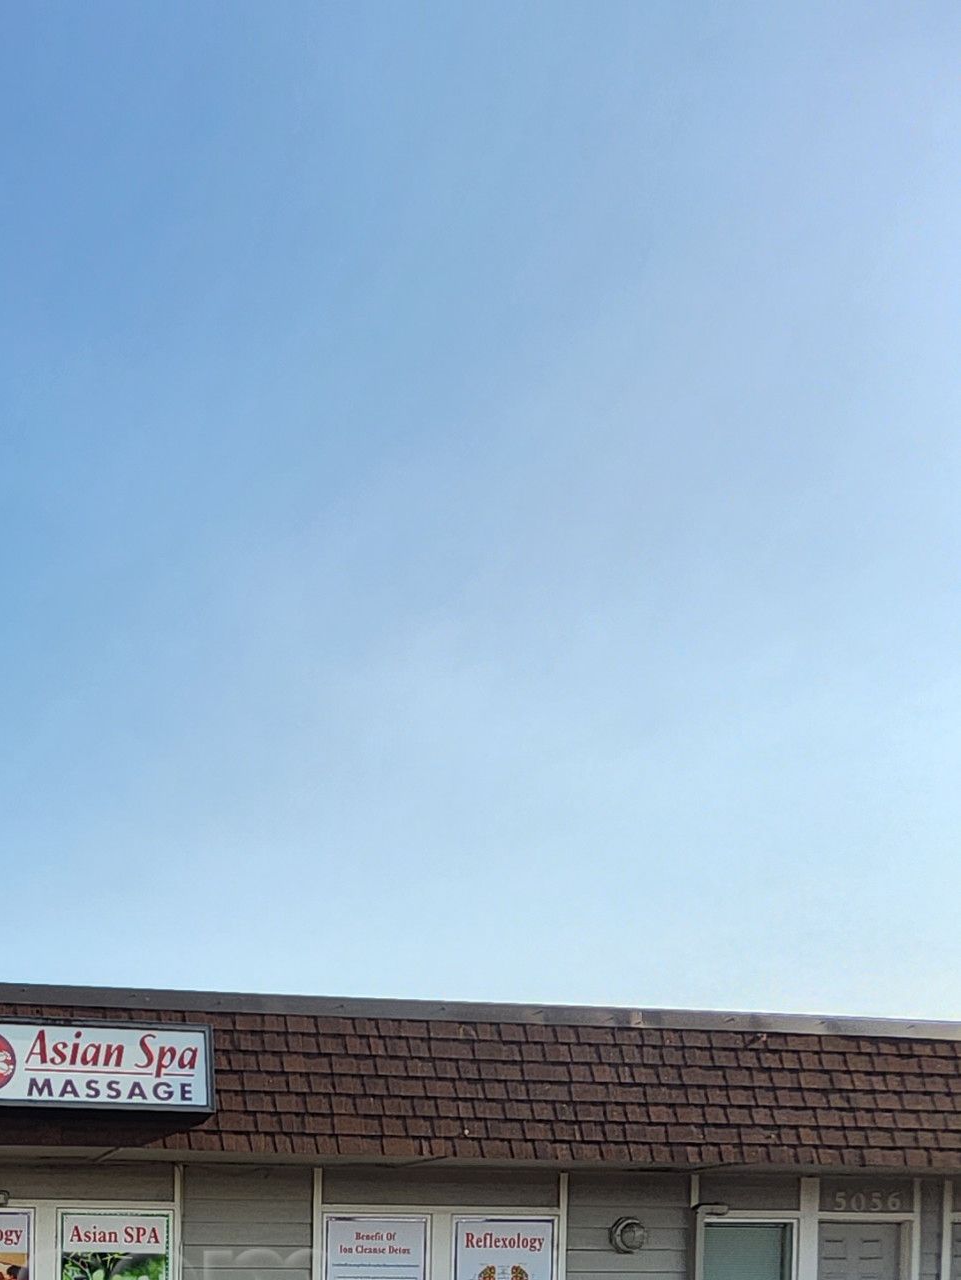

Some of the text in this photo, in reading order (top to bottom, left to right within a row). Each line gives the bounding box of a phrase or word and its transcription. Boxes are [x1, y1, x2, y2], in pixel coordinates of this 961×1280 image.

[25, 1029, 198, 1078] Asian Spa
[27, 1077, 193, 1101] MASSAGE
[833, 1191, 902, 1212] 5056
[70, 1225, 160, 1244] Asian SPA
[355, 1231, 397, 1241] Benefit Of
[465, 1232, 545, 1252] Reflexology
[355, 1245, 386, 1254] Cleanse
[388, 1245, 412, 1255] Detox
